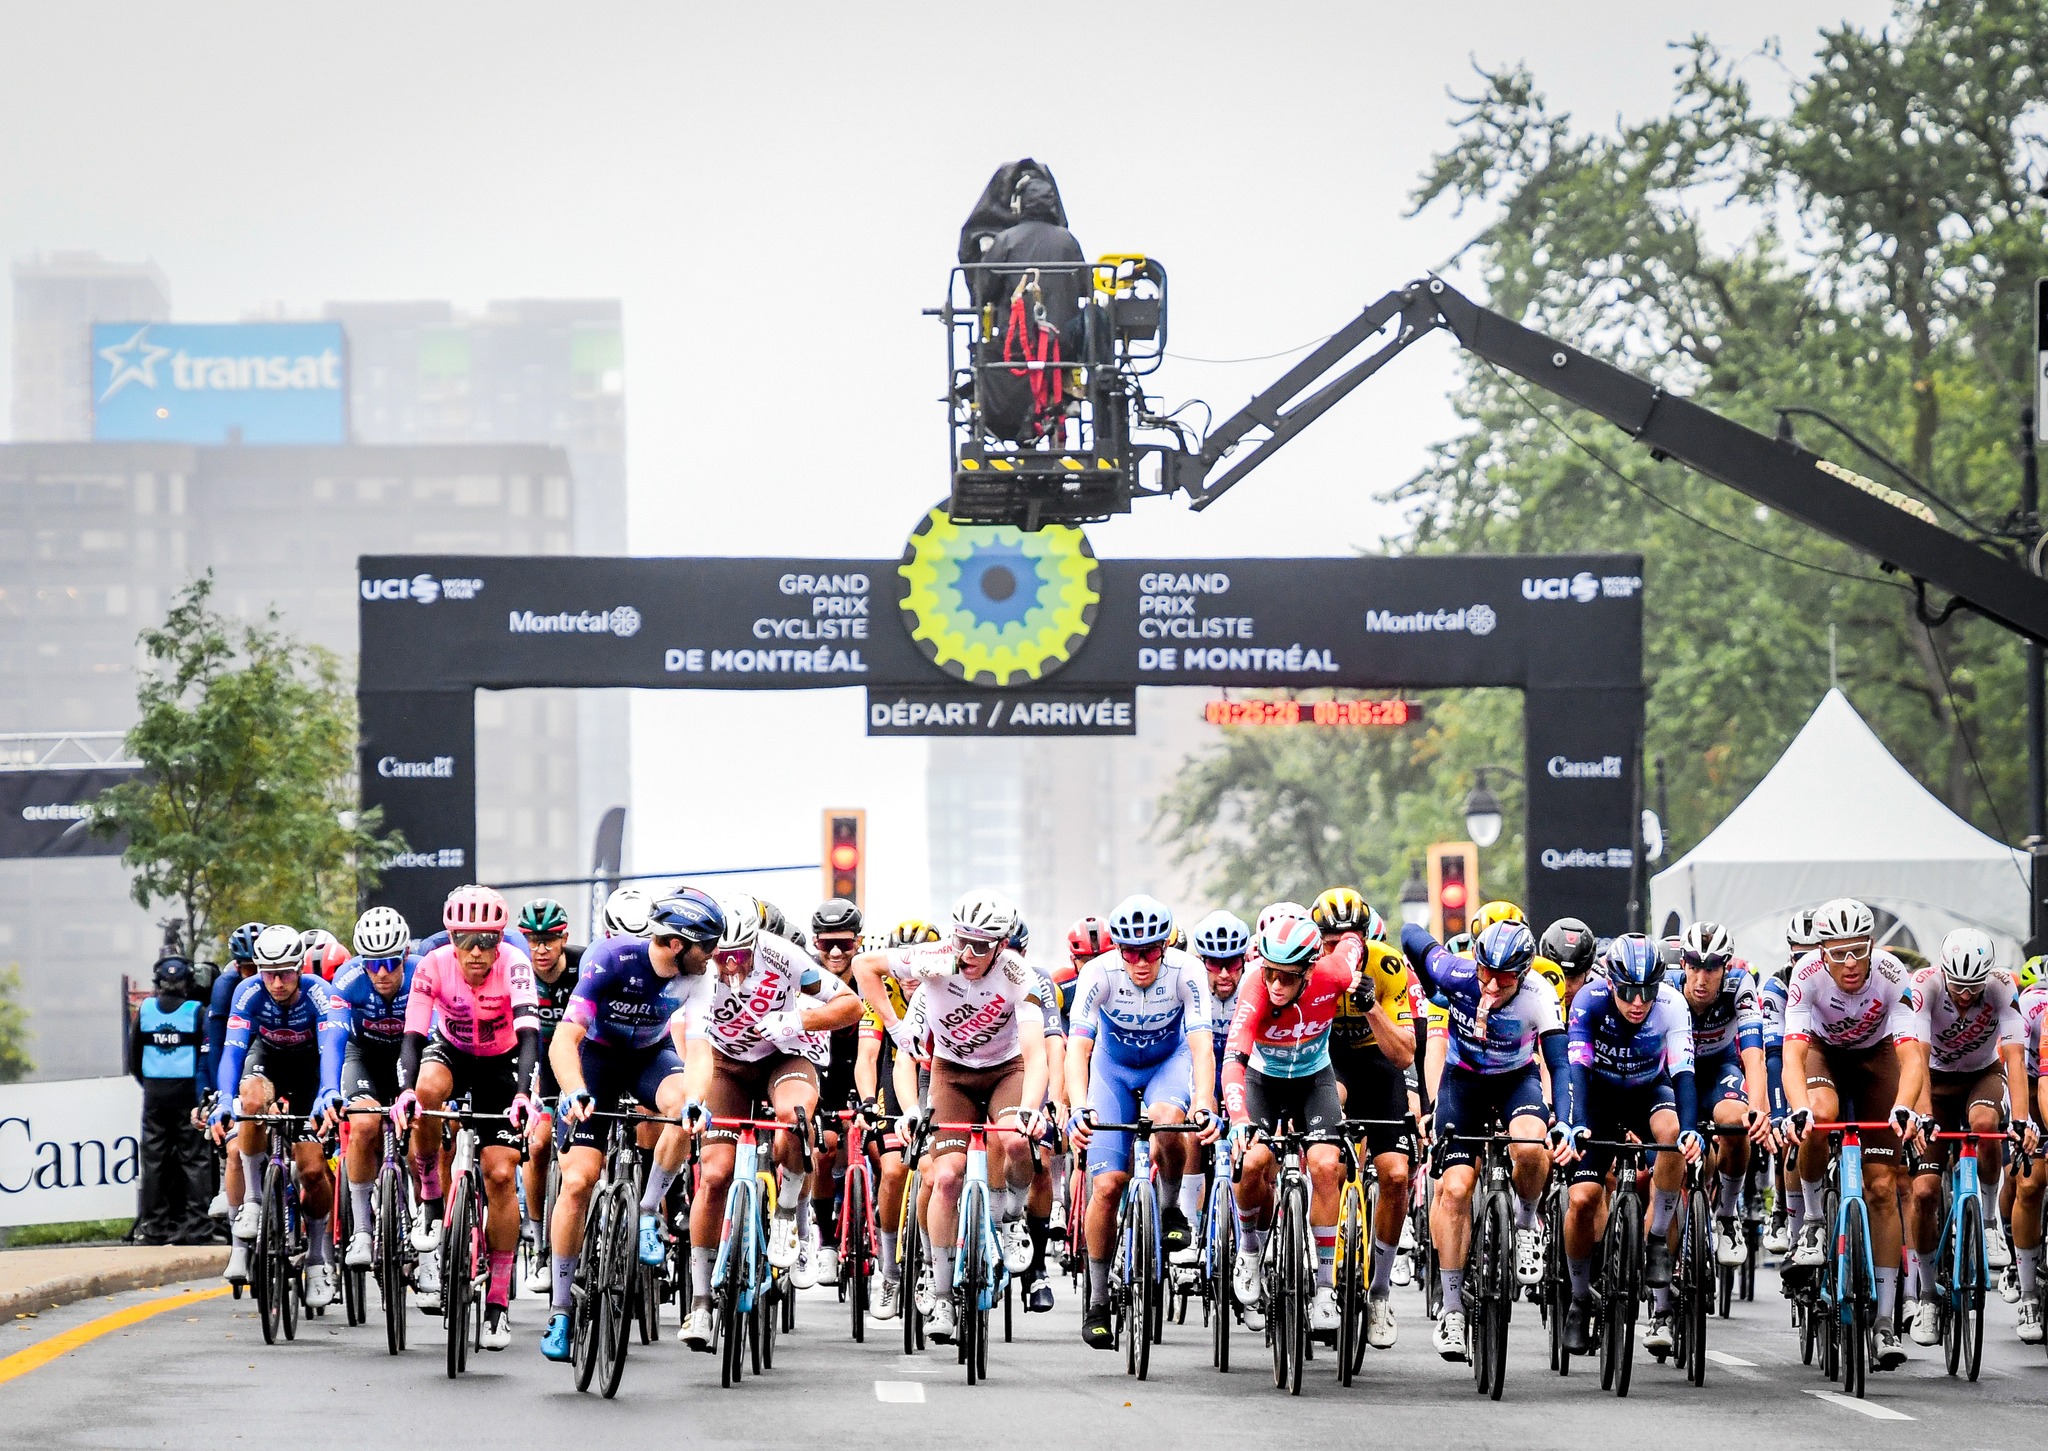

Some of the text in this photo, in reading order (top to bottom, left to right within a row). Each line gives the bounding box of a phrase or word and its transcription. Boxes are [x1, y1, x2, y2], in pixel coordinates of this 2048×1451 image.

[171, 347, 340, 390] transat
[361, 579, 409, 600] UCI
[441, 578, 484, 590] WORLD
[779, 573, 870, 595] GRAND
[1139, 573, 1230, 594] GRAND
[1522, 578, 1569, 600] UCI
[1601, 576, 1643, 588] WORLD
[1603, 587, 1633, 597] TOUR
[443, 588, 475, 599] TOUR
[812, 596, 870, 617] PRIX
[1139, 596, 1196, 616] PRIX
[509, 610, 609, 633] Montréal
[752, 618, 869, 639] CYCLISTE
[1138, 617, 1254, 639] CYCLISTE
[1366, 608, 1465, 632] Montréal
[664, 644, 869, 672] DE MONTRÉAL
[1138, 643, 1340, 672] DE MONTRÉAL
[871, 698, 981, 727] DÉPART
[1009, 697, 1132, 726] ARRIVÉE
[377, 756, 454, 778] Canada
[1547, 756, 1622, 778] Canada
[22, 803, 117, 821] QUÉBEC
[380, 851, 438, 870] uébec
[1541, 848, 1606, 870] Québec
[761, 952, 792, 980] MONDIALE
[762, 946, 791, 968] AG2R LA
[1880, 959, 1902, 975] AG2R LA
[1877, 965, 1901, 985] MONDIALE
[608, 1000, 651, 1015] ISRAEL
[718, 970, 781, 1038] CITROËN
[1081, 983, 1099, 1018] GIANT
[1186, 980, 1202, 1017] GIANT
[538, 1007, 564, 1019] OR
[939, 1003, 979, 1030] AG2R
[951, 993, 1006, 1041] CITROËN
[1108, 1005, 1180, 1025] Jayco
[1448, 1004, 1476, 1029] ISRA
[1830, 998, 1883, 1041] CITROËN
[369, 1023, 404, 1031] Alpec
[949, 1011, 1013, 1059] MONDIALE
[1264, 1018, 1333, 1040] Lotto
[1822, 1016, 1861, 1035] AG2R
[1944, 1003, 1993, 1049] CITROËN
[938, 1035, 956, 1048] LA
[1594, 1039, 1633, 1058] SRAEL
[1937, 1018, 1999, 1065] MONDIALE
[936, 1139, 967, 1149] BMC
[0, 1117, 140, 1194] Cana
[1918, 1162, 1939, 1170] MC
